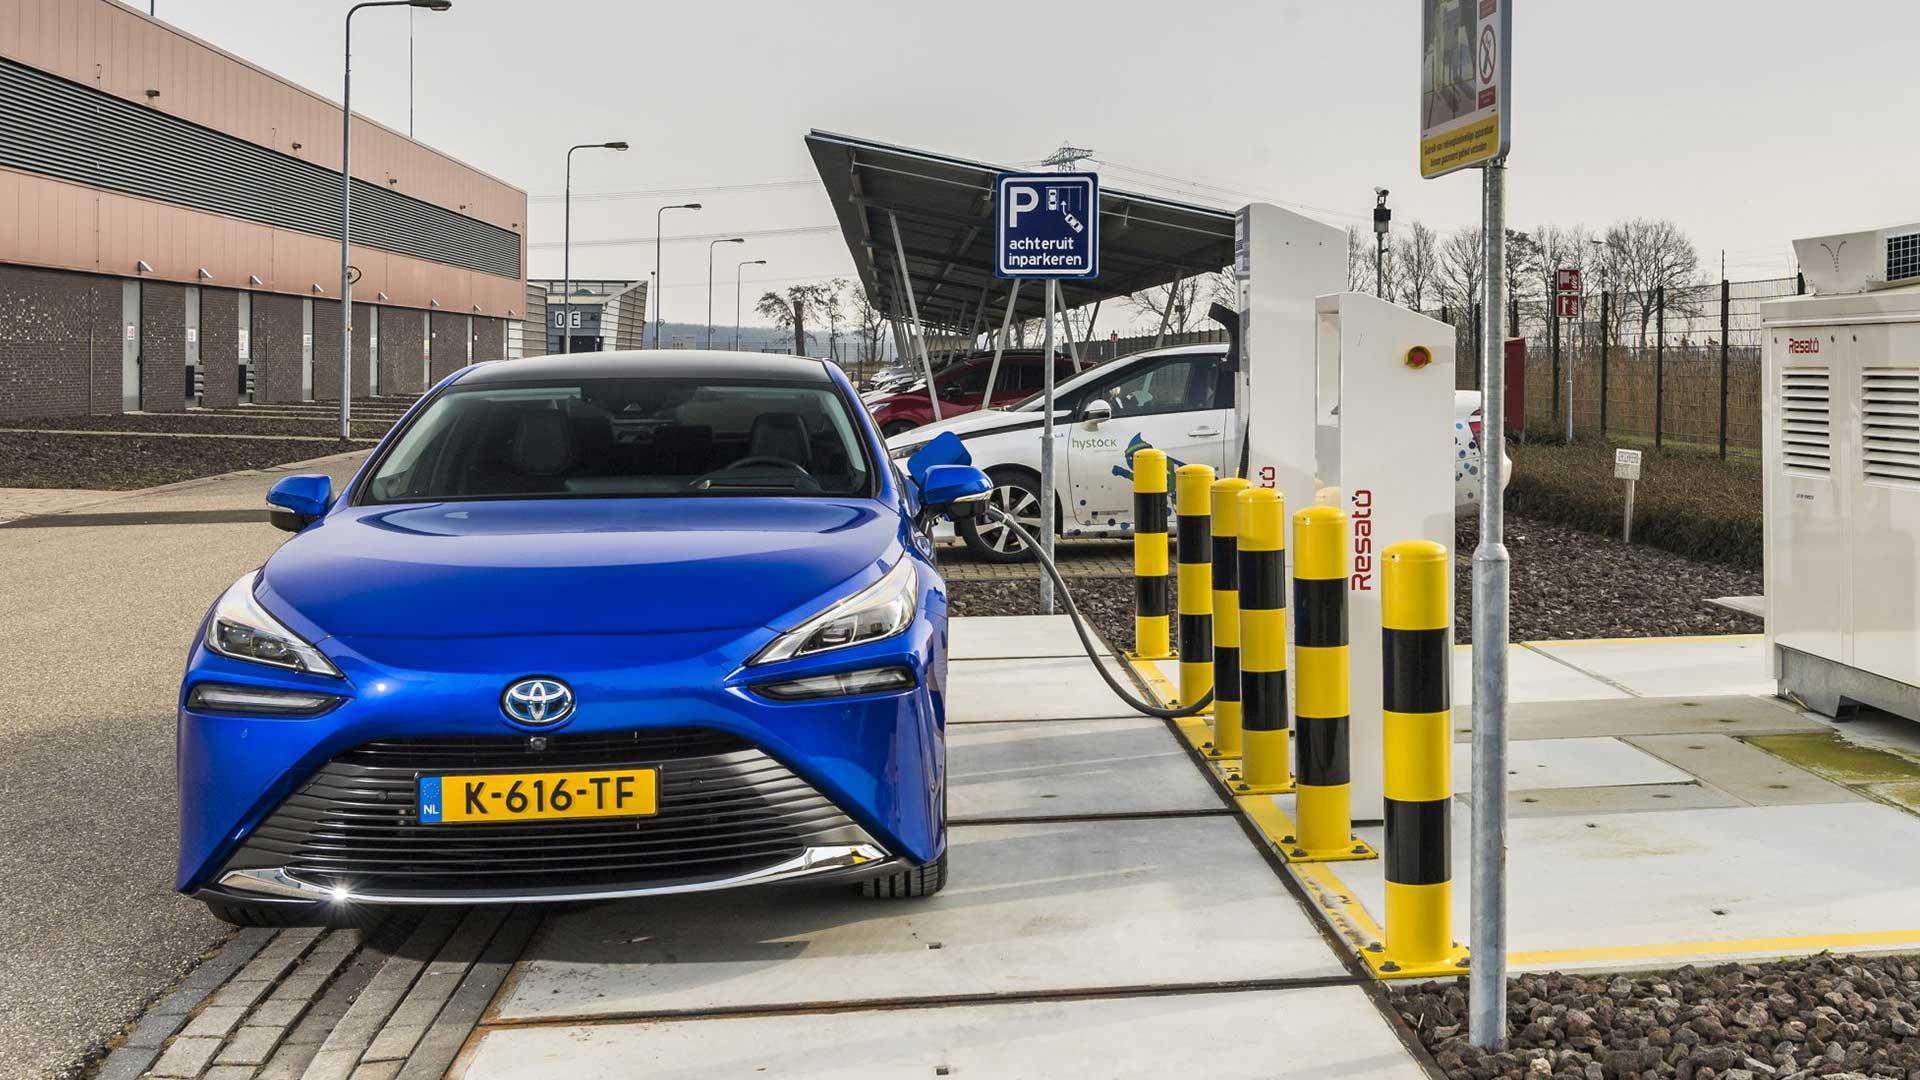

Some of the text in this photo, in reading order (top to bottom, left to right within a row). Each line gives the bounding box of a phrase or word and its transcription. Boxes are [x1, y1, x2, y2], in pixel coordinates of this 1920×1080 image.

[1009, 186, 1039, 228] P
[1009, 237, 1074, 250] achteruit
[1008, 252, 1082, 268] inparkeren
[1788, 337, 1820, 354] Resato
[1072, 437, 1117, 450] hystock
[1351, 489, 1372, 590] Resato
[465, 776, 635, 815] K-616-TF
[423, 804, 440, 815] NL
